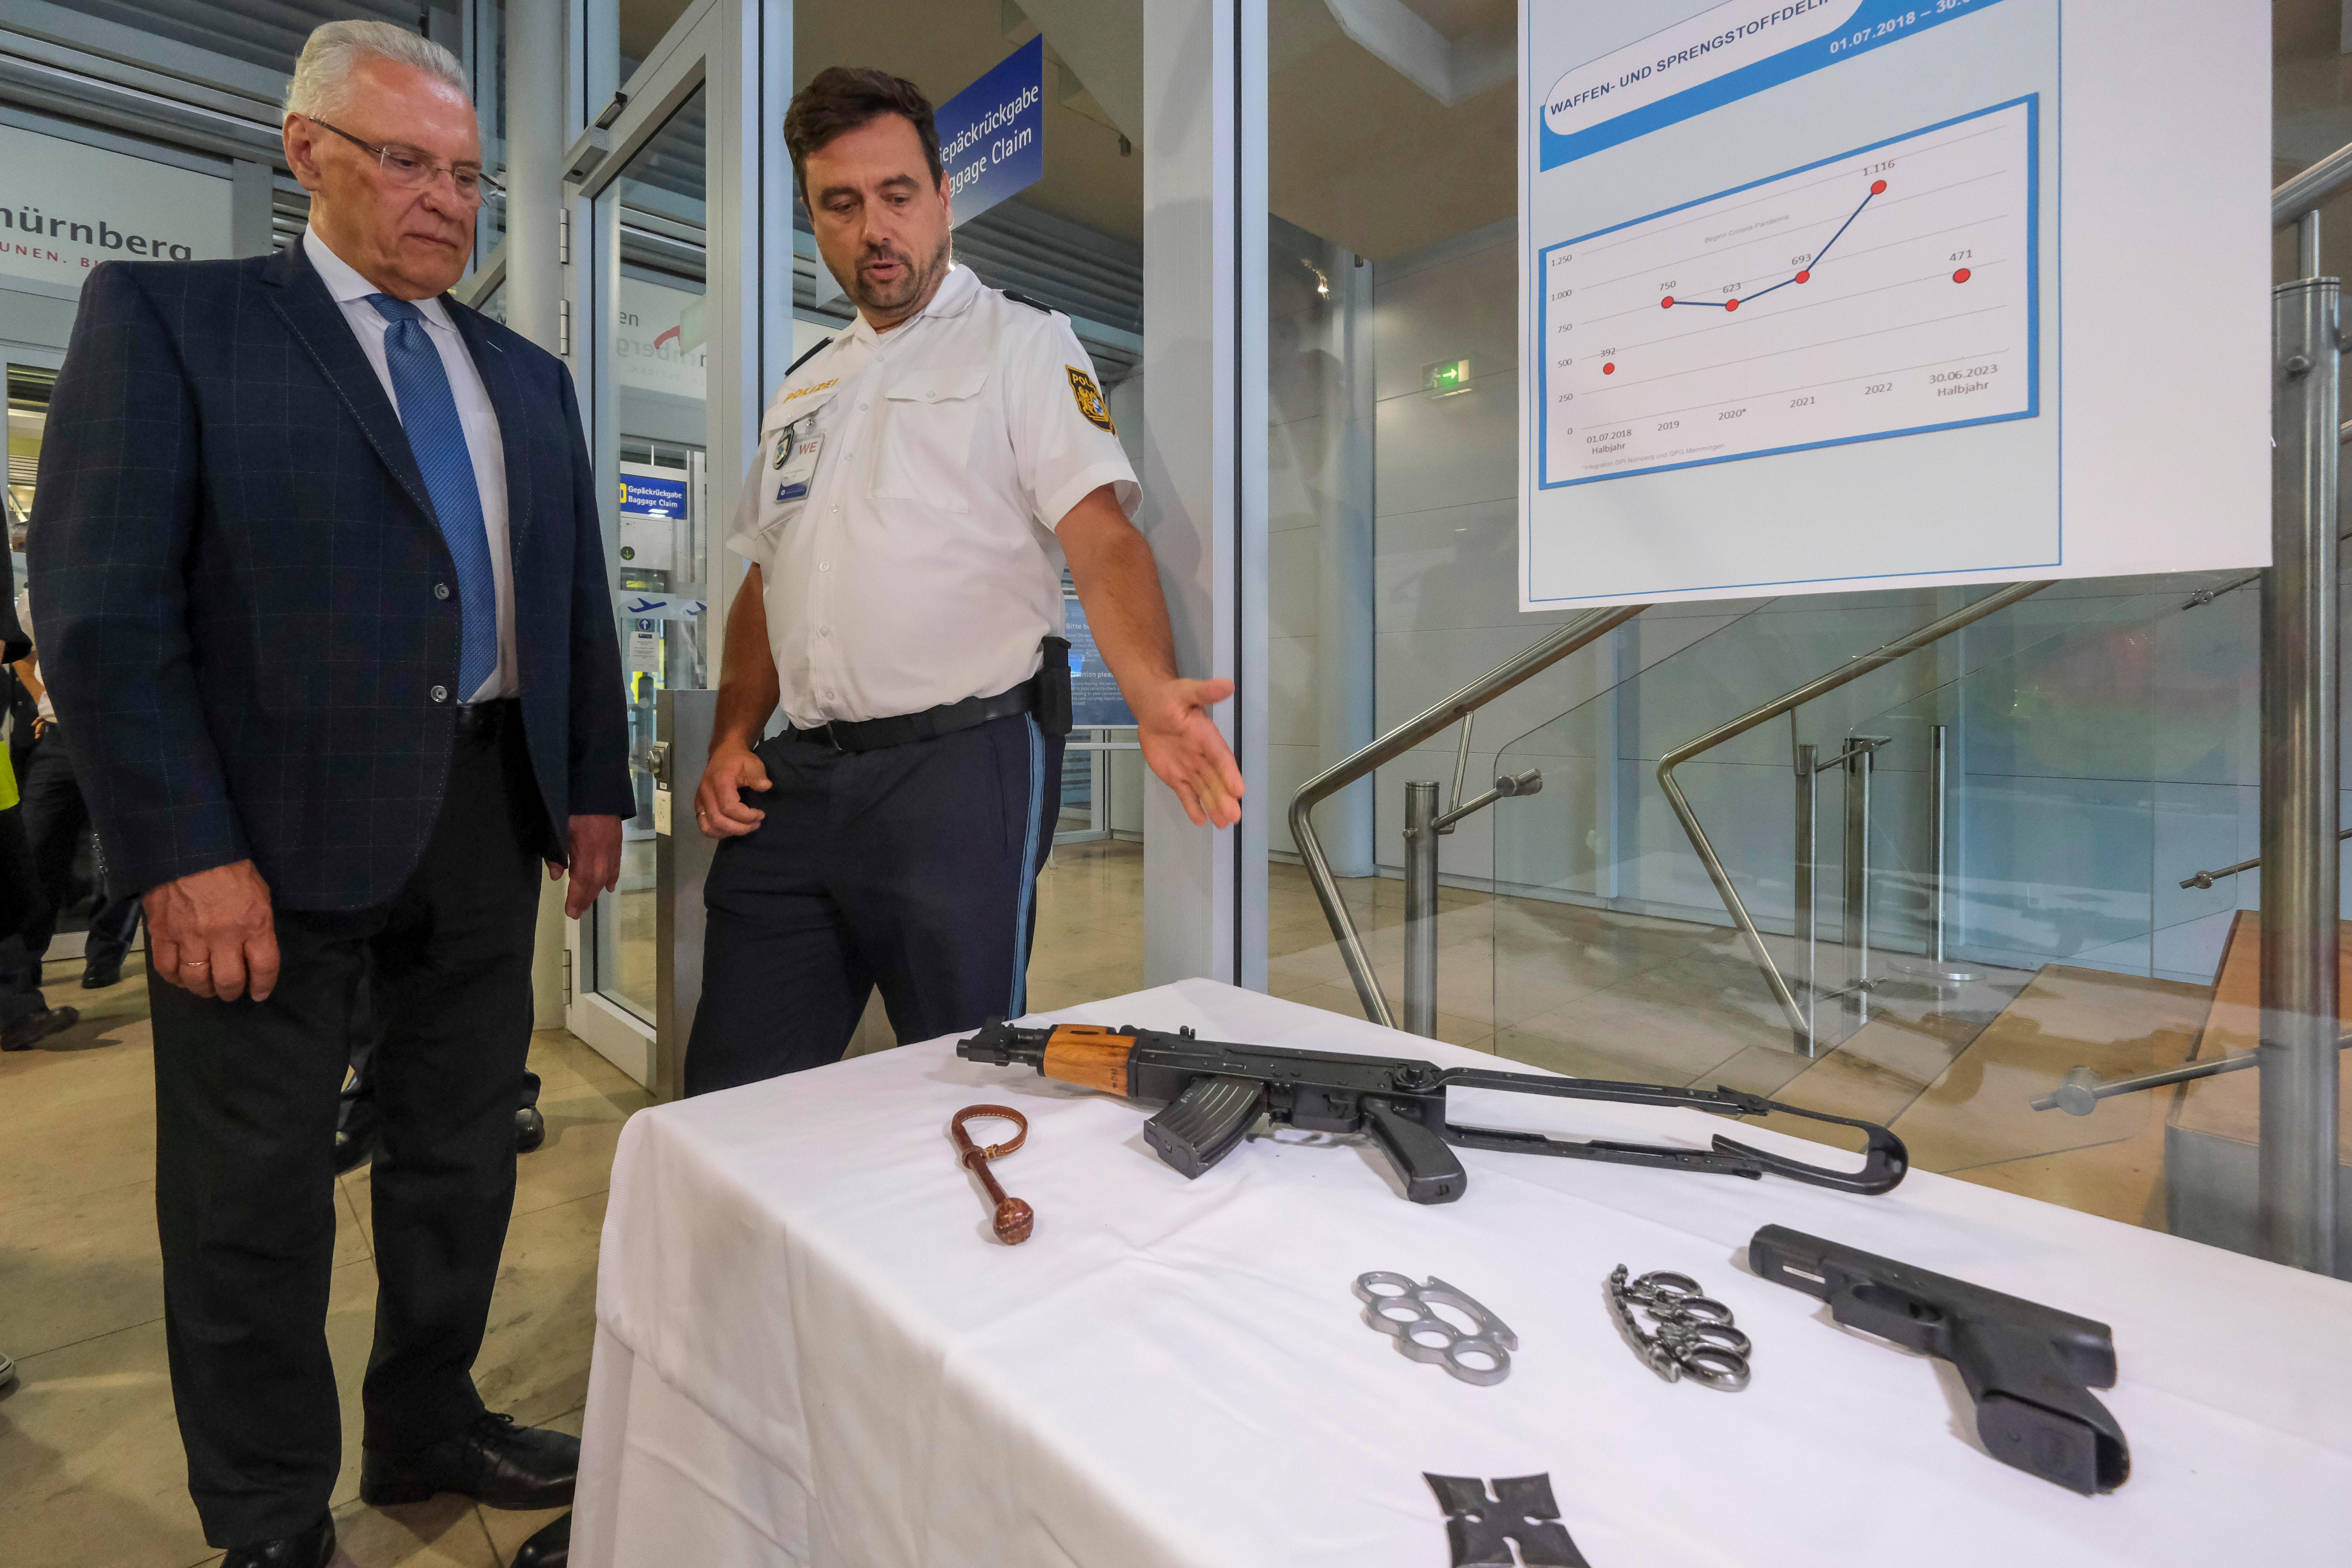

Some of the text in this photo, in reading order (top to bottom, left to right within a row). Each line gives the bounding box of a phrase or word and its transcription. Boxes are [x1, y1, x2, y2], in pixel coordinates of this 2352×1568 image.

[1830, 11, 1916, 54] 01.07.2018
[1936, 0, 1970, 13] 30.
[1550, 84, 1616, 115] WAFFEN-
[1620, 65, 1652, 88] UND
[939, 85, 1039, 164] epäckrückgabe
[950, 127, 1032, 198] ggage Claim
[1863, 160, 1895, 176] 1.116
[1705, 214, 1789, 243] Beginn Corona-Pandemie
[1551, 254, 1572, 266] 1.250
[1792, 254, 1811, 266] 693
[1949, 250, 1973, 261] 471
[1659, 280, 1676, 291] 750
[1723, 282, 1741, 294] 623
[1551, 289, 1572, 301] 1.000
[1558, 324, 1572, 333] 750
[1600, 348, 1616, 358] 392
[1558, 358, 1572, 368] 500
[1929, 364, 1998, 384] 30.06.2023
[783, 377, 839, 404] POLIZEI
[1865, 382, 1893, 395] 2022
[1937, 381, 1990, 397] Halbjahr
[1558, 393, 1573, 403] 250
[1790, 396, 1815, 408] 2021
[1657, 420, 1680, 431] 2019
[1587, 429, 1632, 444] 01.07.2018
[1592, 443, 1626, 454] Halbjahr
[1686, 444, 1724, 454] Memmingen
[628, 486, 682, 499] Gepäckrückgabe
[628, 496, 678, 508] Baggage Claim
